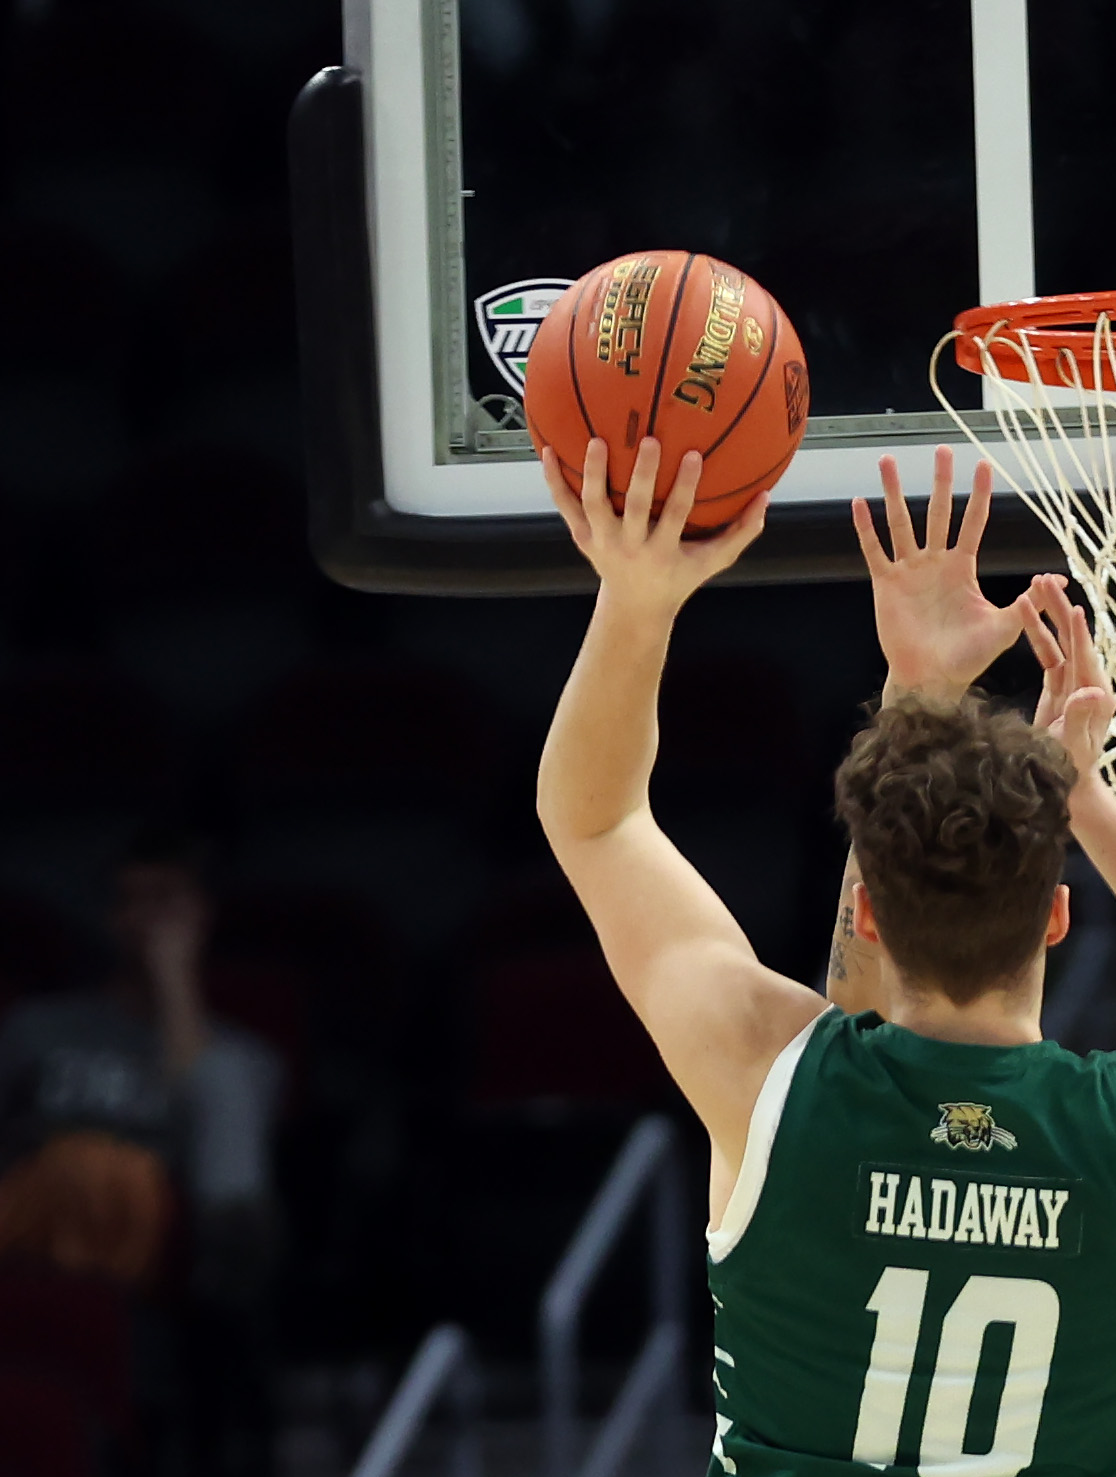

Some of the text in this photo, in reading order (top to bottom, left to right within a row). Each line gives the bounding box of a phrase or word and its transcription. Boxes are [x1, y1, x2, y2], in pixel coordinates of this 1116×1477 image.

[614, 257, 662, 376] EGACY
[672, 258, 747, 414] PALDING
[865, 1170, 1069, 1249] HADAWAY
